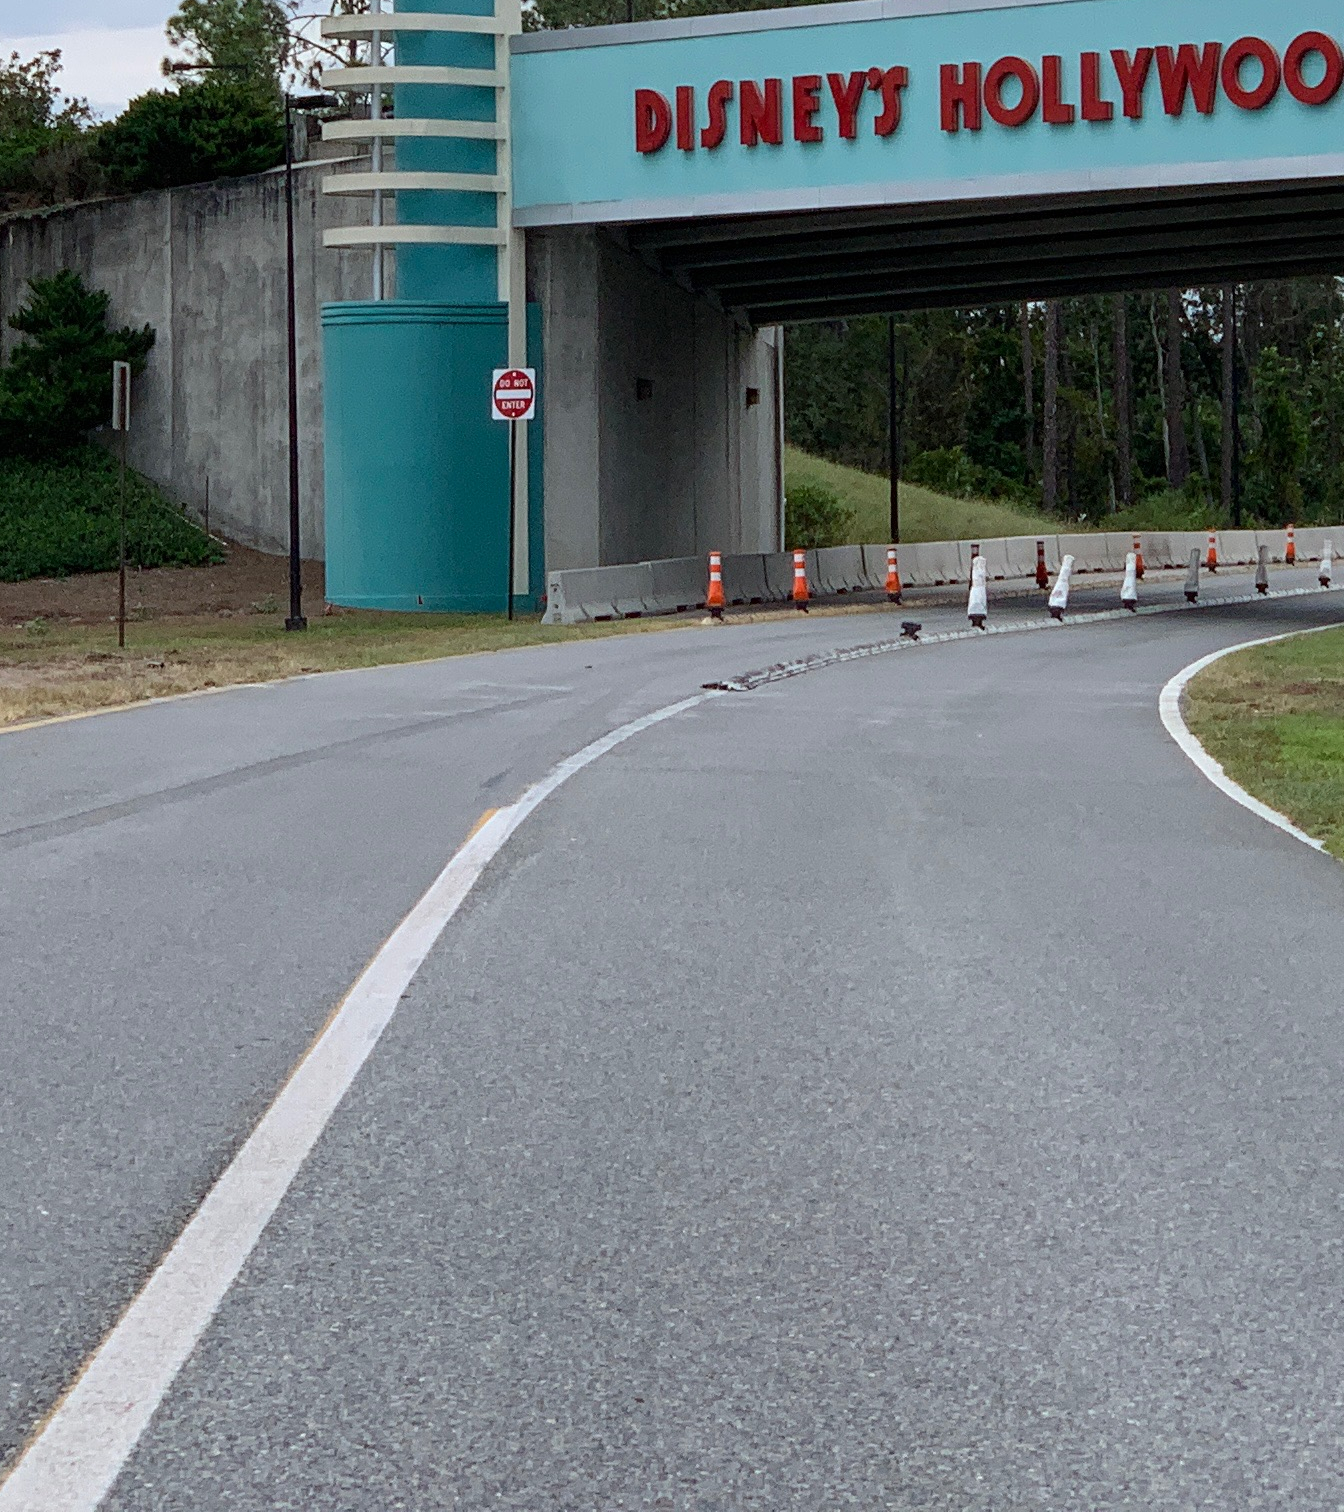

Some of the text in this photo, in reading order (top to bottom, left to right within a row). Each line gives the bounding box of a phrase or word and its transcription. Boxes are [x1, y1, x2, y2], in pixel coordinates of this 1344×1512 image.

[635, 65, 908, 153] DISNEY'S
[499, 378, 529, 388] DO NOT
[501, 400, 526, 409] ENTER
